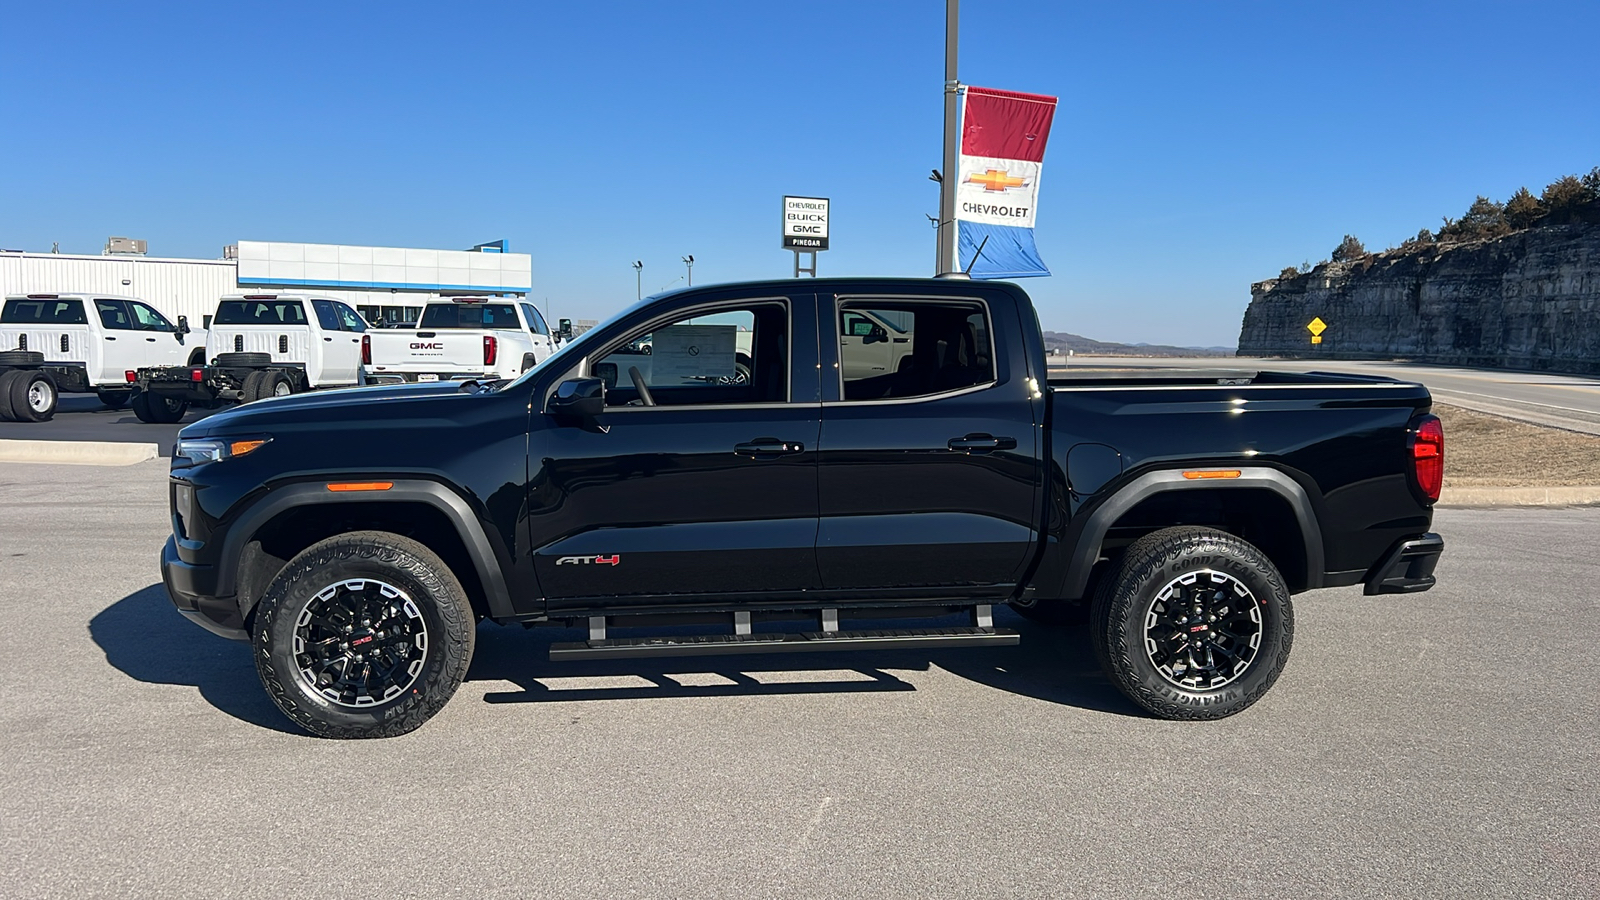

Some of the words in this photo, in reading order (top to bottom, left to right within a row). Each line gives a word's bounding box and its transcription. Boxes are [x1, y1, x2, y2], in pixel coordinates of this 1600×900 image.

[789, 202, 826, 210] CHEVROLET
[962, 202, 1028, 218] CHEVROLET
[788, 213, 826, 222] BUICK
[793, 225, 821, 233] GMC
[556, 555, 619, 566] AT4
[1153, 683, 1238, 706] WRANGLER
